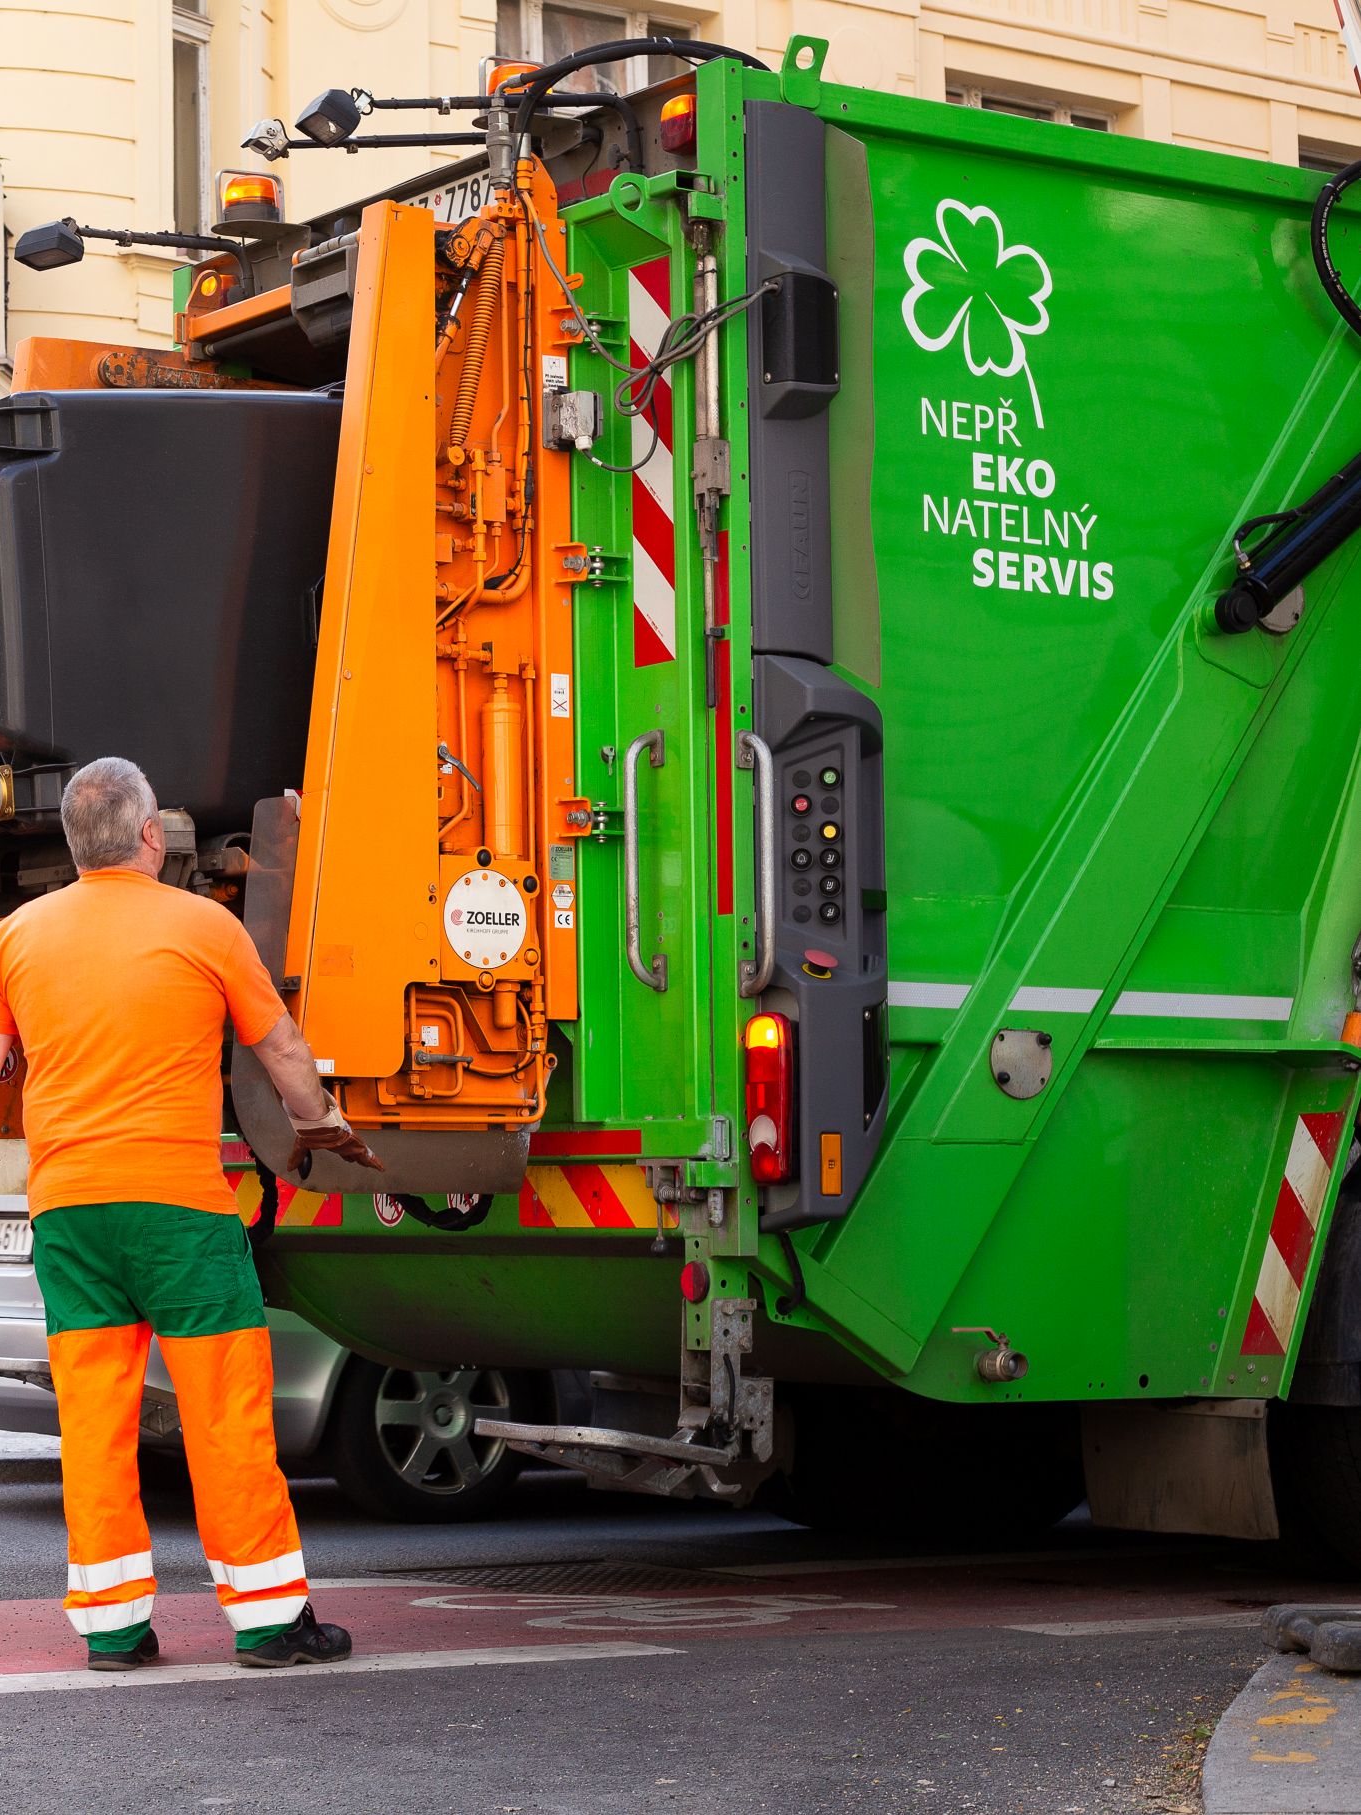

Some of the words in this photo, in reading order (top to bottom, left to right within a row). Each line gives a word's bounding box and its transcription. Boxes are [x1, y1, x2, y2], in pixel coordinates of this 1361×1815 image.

[445, 173, 491, 222] 7787
[921, 397, 1022, 447] NEPŘ
[972, 452, 1056, 499] EKO
[923, 494, 1098, 550] NATELNÝ
[972, 548, 1114, 600] SERVIS
[466, 911, 520, 926] ZOELLER
[557, 914, 570, 925] CE
